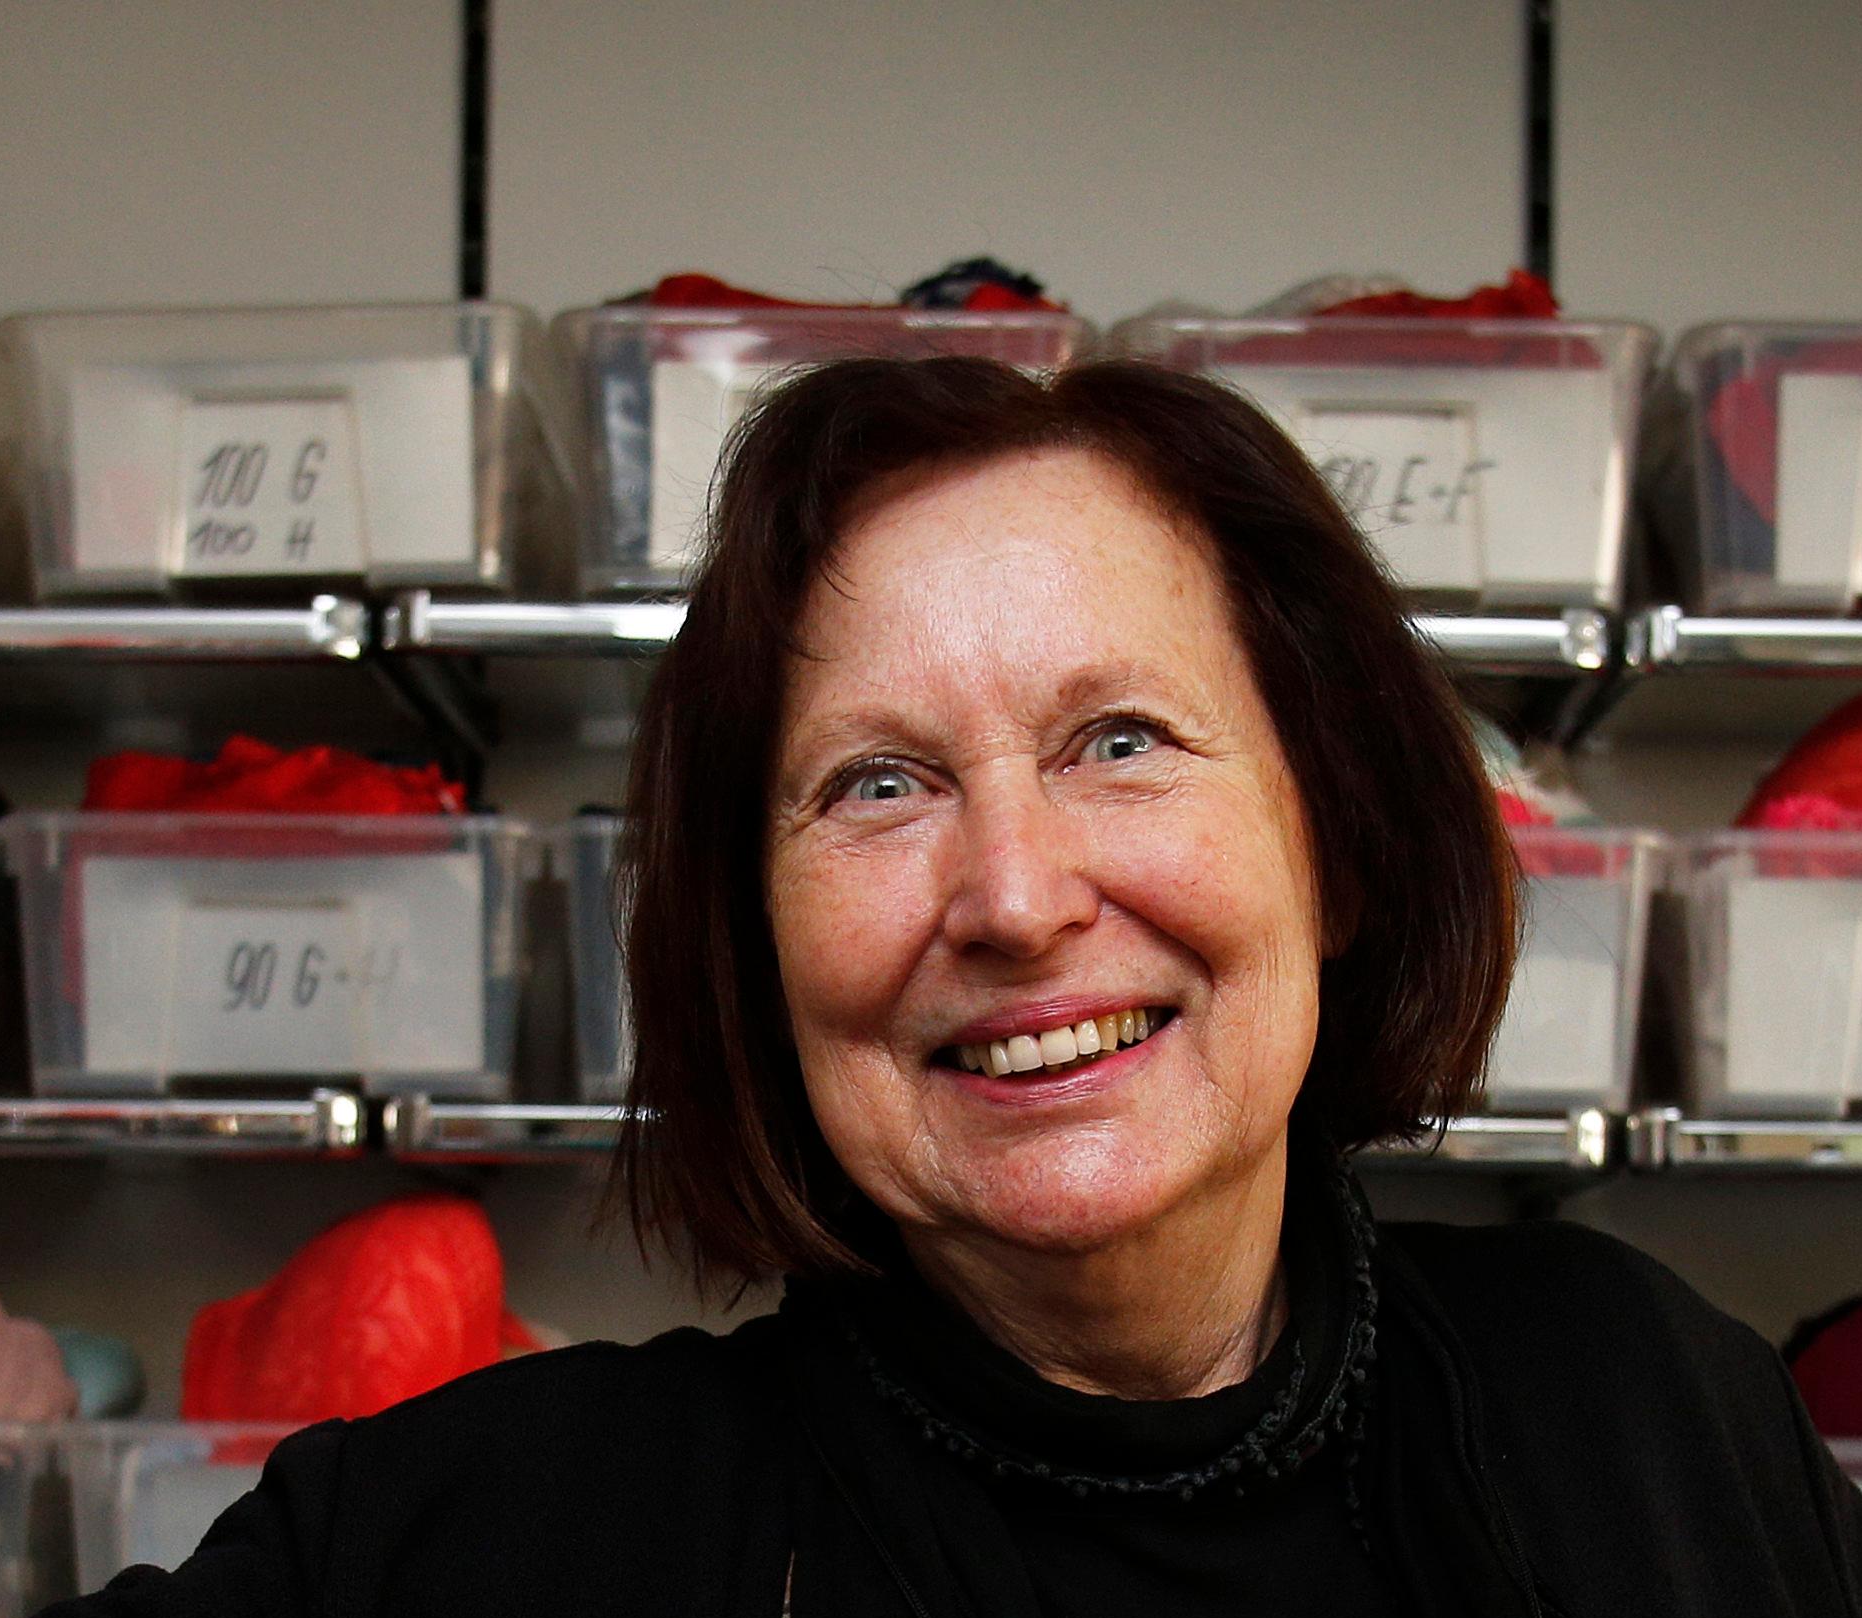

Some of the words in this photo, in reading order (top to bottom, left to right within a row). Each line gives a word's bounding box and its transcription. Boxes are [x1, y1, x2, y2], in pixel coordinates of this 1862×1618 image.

[193, 440, 266, 512] 100
[286, 436, 328, 507] G
[186, 518, 256, 560] 100
[282, 517, 318, 558] H
[221, 938, 278, 1012] 90
